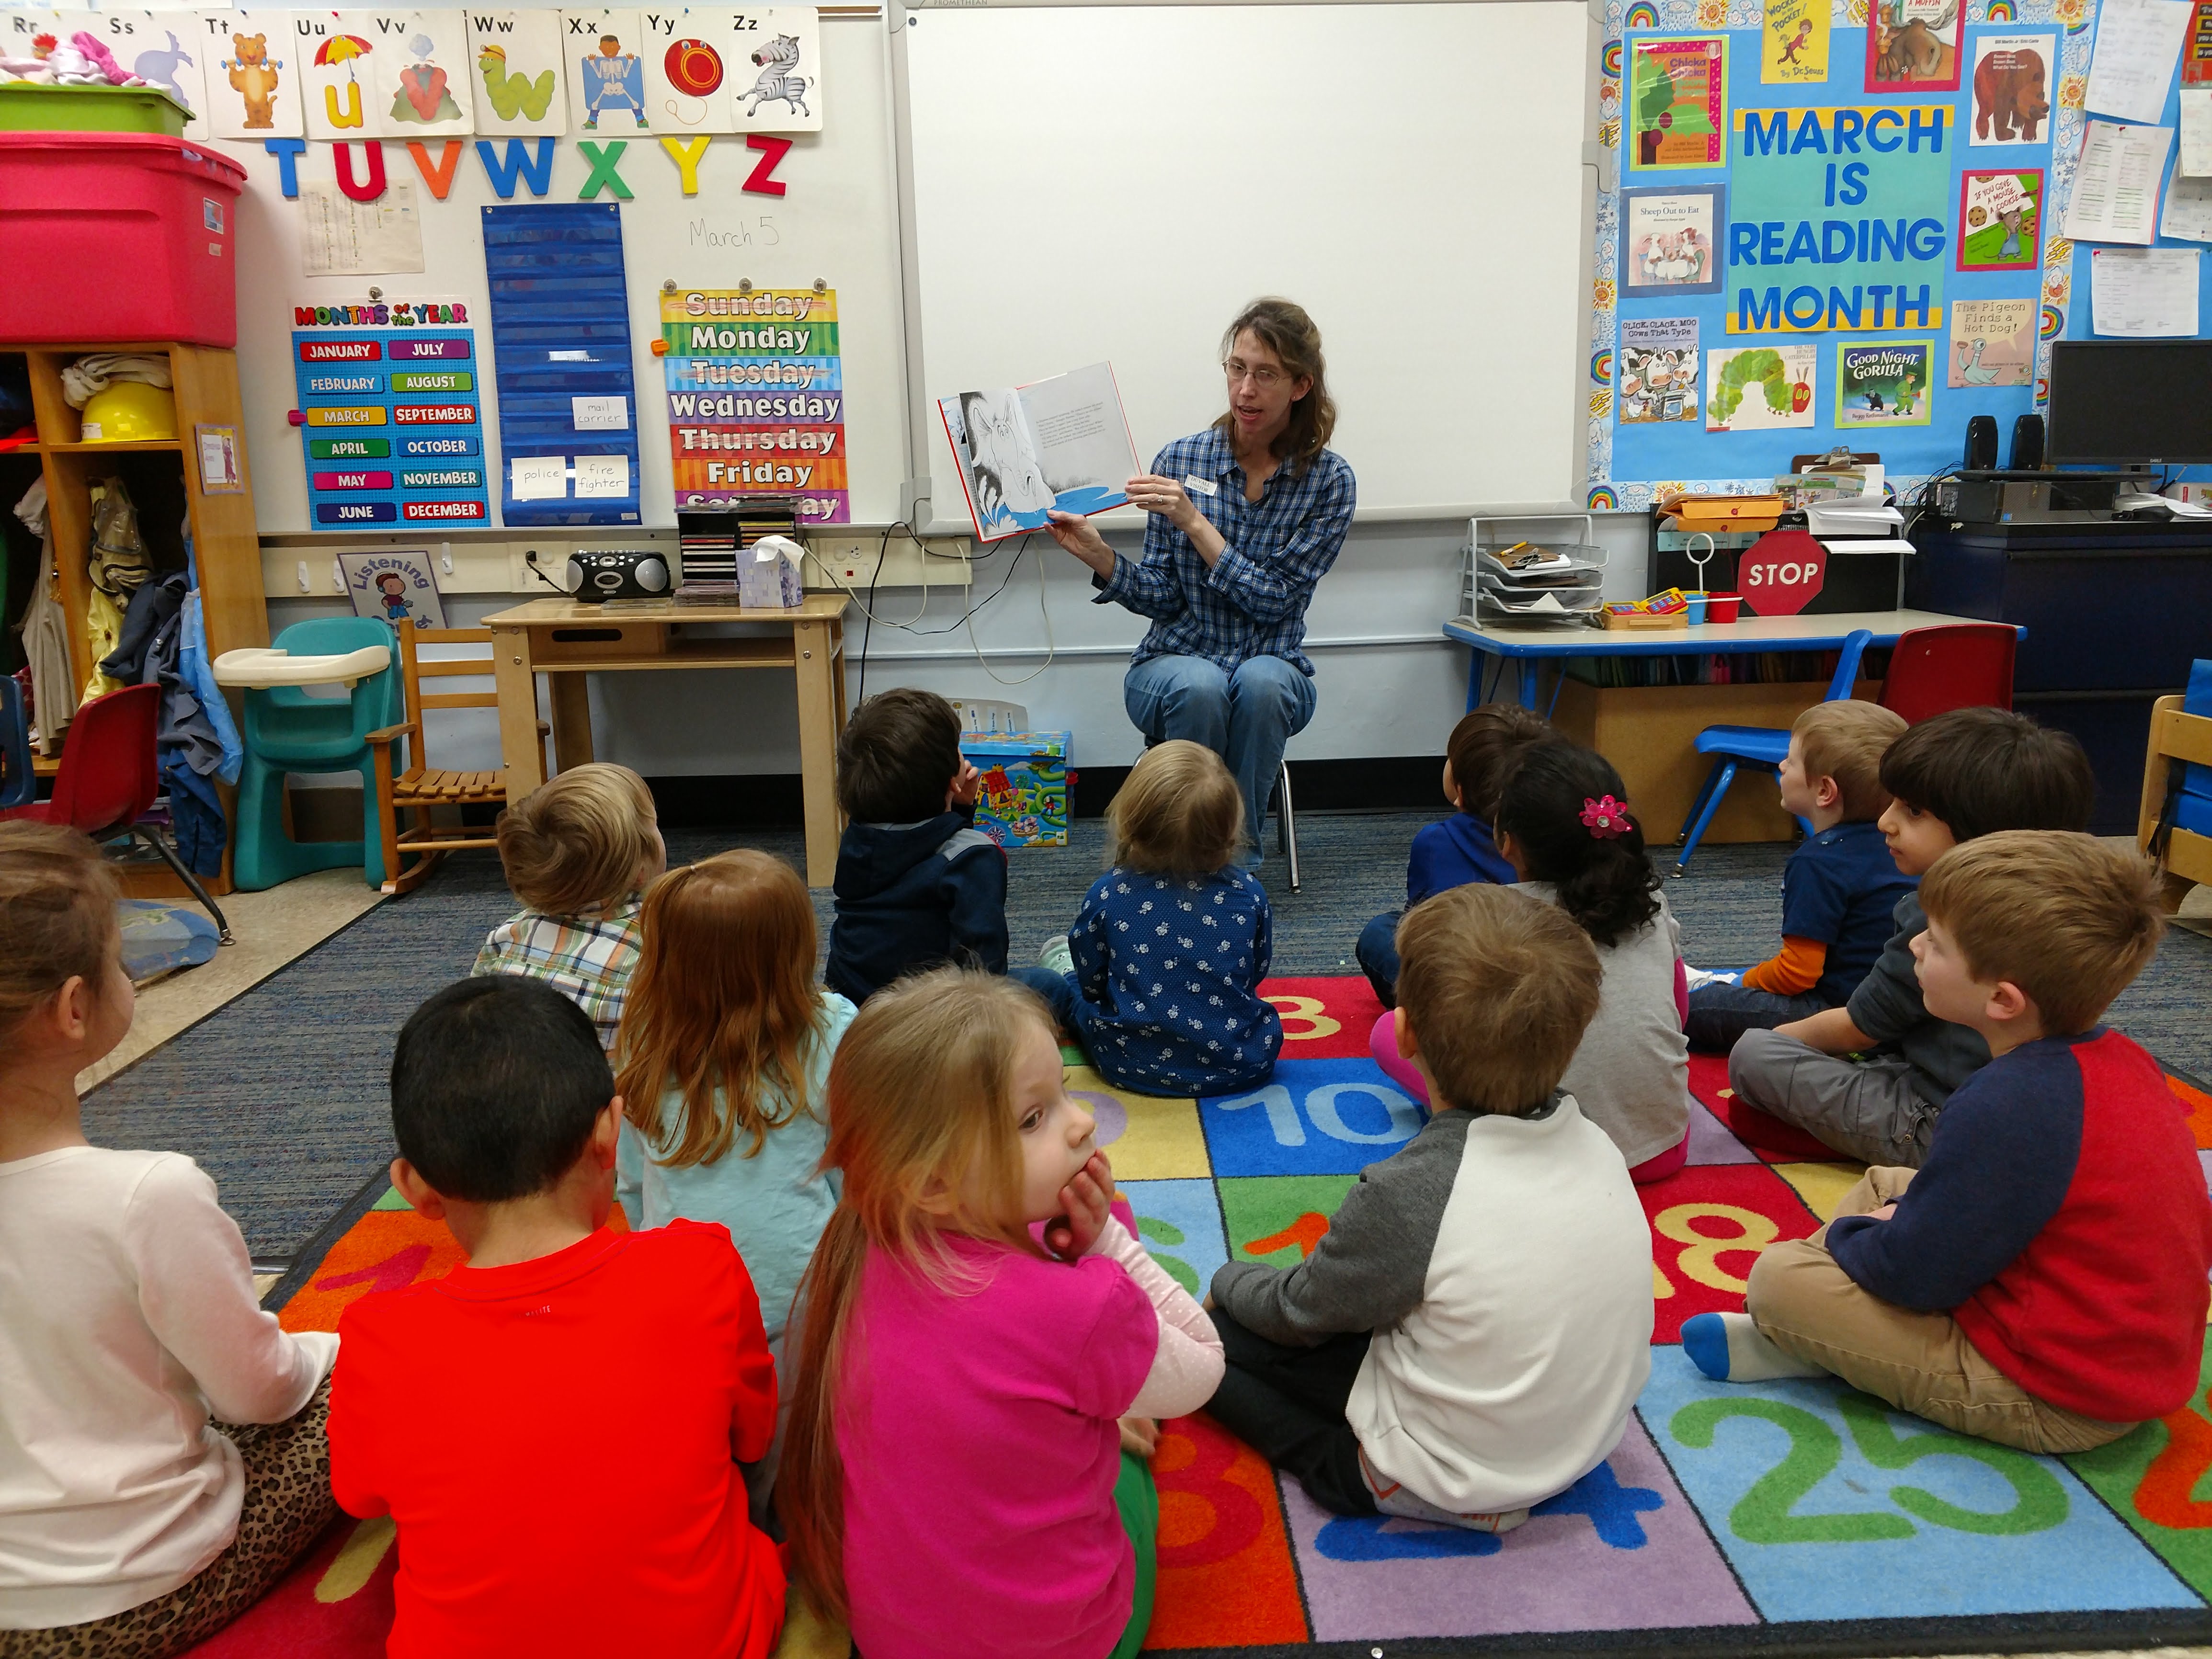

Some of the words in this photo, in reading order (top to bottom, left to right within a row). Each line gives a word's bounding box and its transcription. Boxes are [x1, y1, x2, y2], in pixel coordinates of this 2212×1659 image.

[1767, 0, 1798, 17] WOCKE
[13, 16, 39, 34] Rr
[110, 18, 134, 34] Ss
[205, 18, 228, 34] Tt
[376, 18, 405, 34] Vv
[475, 16, 513, 34] Ww
[569, 18, 598, 34] Xx
[648, 15, 675, 35] Yy
[734, 15, 758, 31] Zz
[1771, 3, 1807, 33] POCKET!
[297, 19, 326, 35] Uu
[1670, 57, 1706, 67] Chicka
[1670, 68, 1706, 77] Chicka
[1744, 109, 1944, 156] MARCH
[264, 139, 305, 197] T
[332, 141, 386, 201] U
[406, 141, 463, 199] V
[475, 136, 555, 198] W
[577, 141, 635, 199] X
[660, 136, 713, 195] Y
[741, 134, 793, 196] Z
[1824, 162, 1870, 207] IS
[1974, 191, 1981, 201] IF
[1982, 185, 1994, 196] YOU
[1995, 179, 2011, 190] GIVE
[1993, 187, 2016, 202] MOUSE
[1996, 194, 2020, 210] COOKIE
[1641, 208, 1661, 216] Sheep
[689, 219, 753, 249] March
[759, 216, 779, 245] 5
[1730, 218, 1946, 266] READING
[394, 303, 409, 314] of
[413, 303, 467, 324] YEAR
[685, 293, 813, 320] Sunday
[1738, 284, 1930, 330] MONTH
[1956, 303, 1976, 312] The
[1982, 302, 2025, 313] Pigeon
[295, 305, 388, 326] MONTHS
[391, 313, 414, 326] the
[1966, 314, 2001, 322] Finds
[1650, 320, 1677, 329] CLACK,
[1964, 324, 1984, 332] Hot
[1990, 323, 2018, 333] Dog!
[691, 326, 811, 354] Monday
[1672, 329, 1691, 337] Type
[309, 344, 371, 358] JANUARY
[411, 342, 444, 356] JULY
[1847, 353, 1879, 368] GOOD
[690, 360, 815, 389] Tuesday
[1853, 364, 1903, 380] GORILLA
[310, 376, 376, 391] FEBRUARY
[406, 375, 456, 388] AUGUST
[396, 407, 472, 421] SEPTEMBER
[588, 400, 609, 412] mail
[670, 394, 841, 422] Wednesday
[324, 410, 370, 423] MARCH
[578, 414, 621, 423] carrier
[331, 442, 369, 455] APRIL
[407, 440, 467, 453] OCTOBER
[679, 428, 837, 454] Thursday
[524, 468, 559, 483] police
[589, 464, 614, 475] fire
[707, 460, 813, 488] Friday
[338, 474, 366, 487] MAY
[403, 471, 477, 485] NOVEMBER
[579, 478, 625, 493] fighter
[1191, 477, 1210, 487] DUVALL
[1190, 482, 1208, 492] VISITOR
[338, 506, 374, 518] JUNE
[408, 504, 478, 517] DECEMBER
[353, 558, 430, 590] Listening
[1748, 562, 1818, 587] STOP
[1217, 1082, 1425, 1147] 10
[1670, 1393, 2071, 1545] 25
